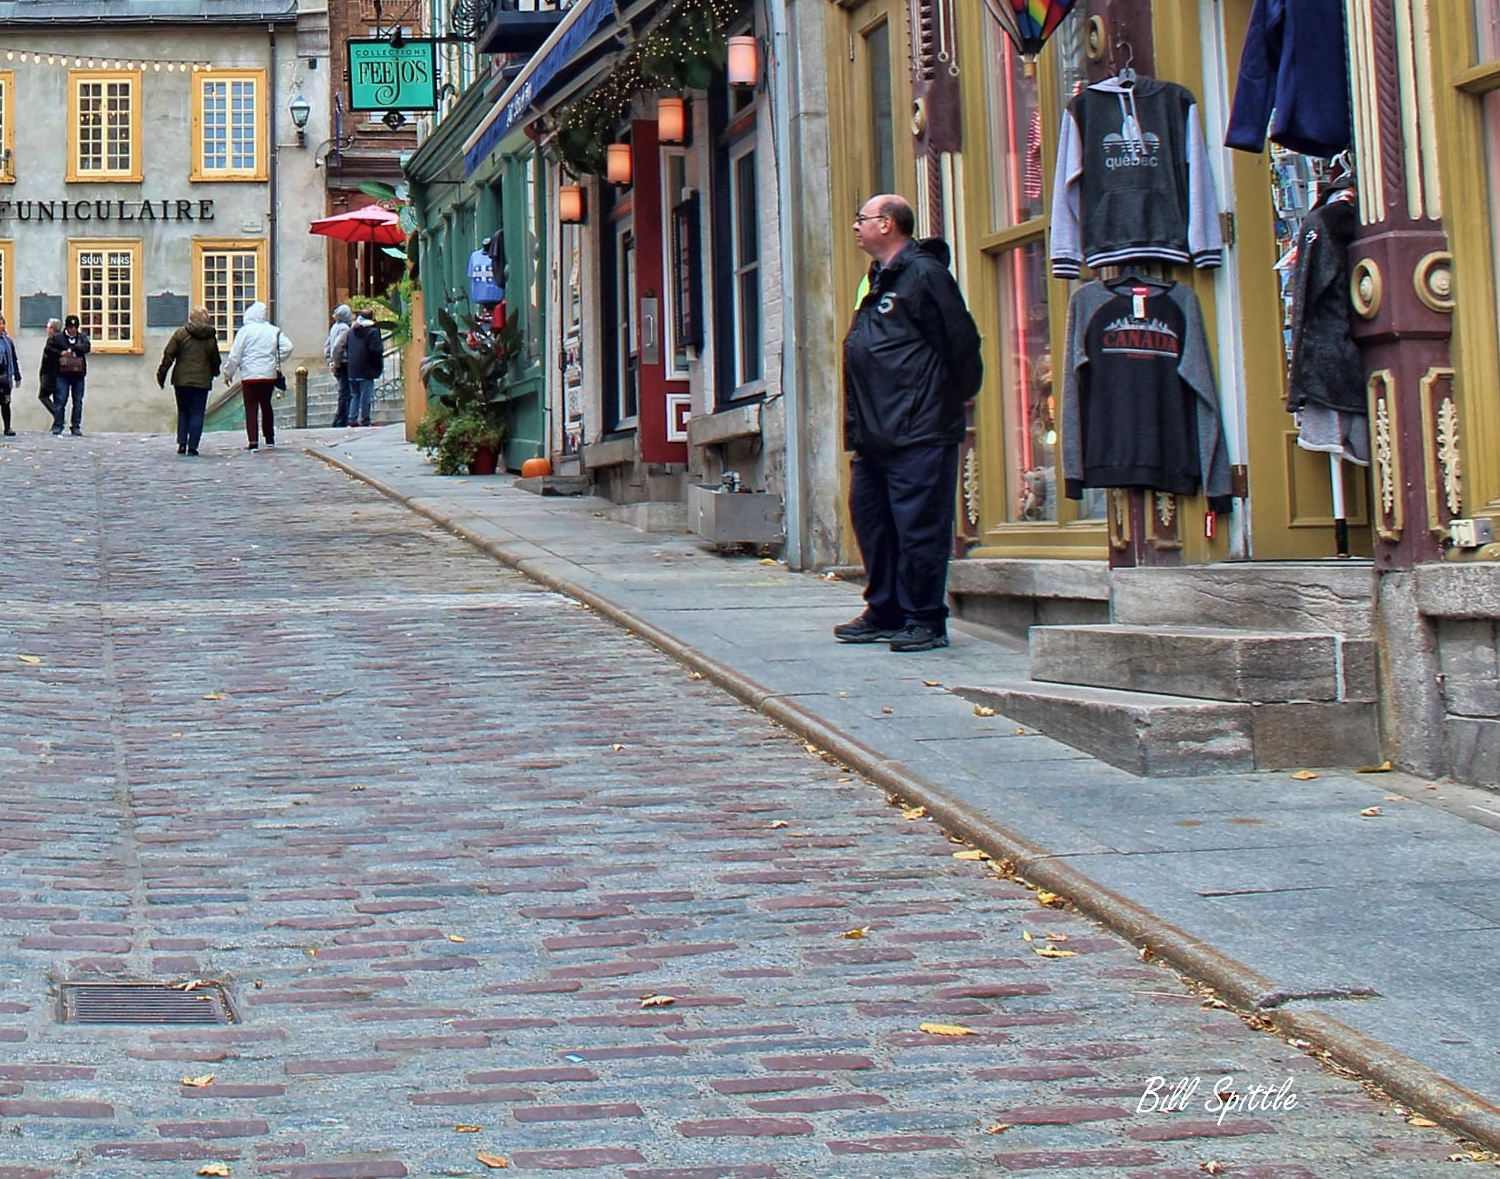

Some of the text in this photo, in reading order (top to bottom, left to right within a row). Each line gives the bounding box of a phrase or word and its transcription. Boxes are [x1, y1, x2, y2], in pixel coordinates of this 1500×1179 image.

[355, 49, 427, 57] COLLECTIONS
[1105, 153, 1158, 170] québec
[81, 255, 130, 265] SOUVNIRS
[1103, 329, 1179, 353] CANADA
